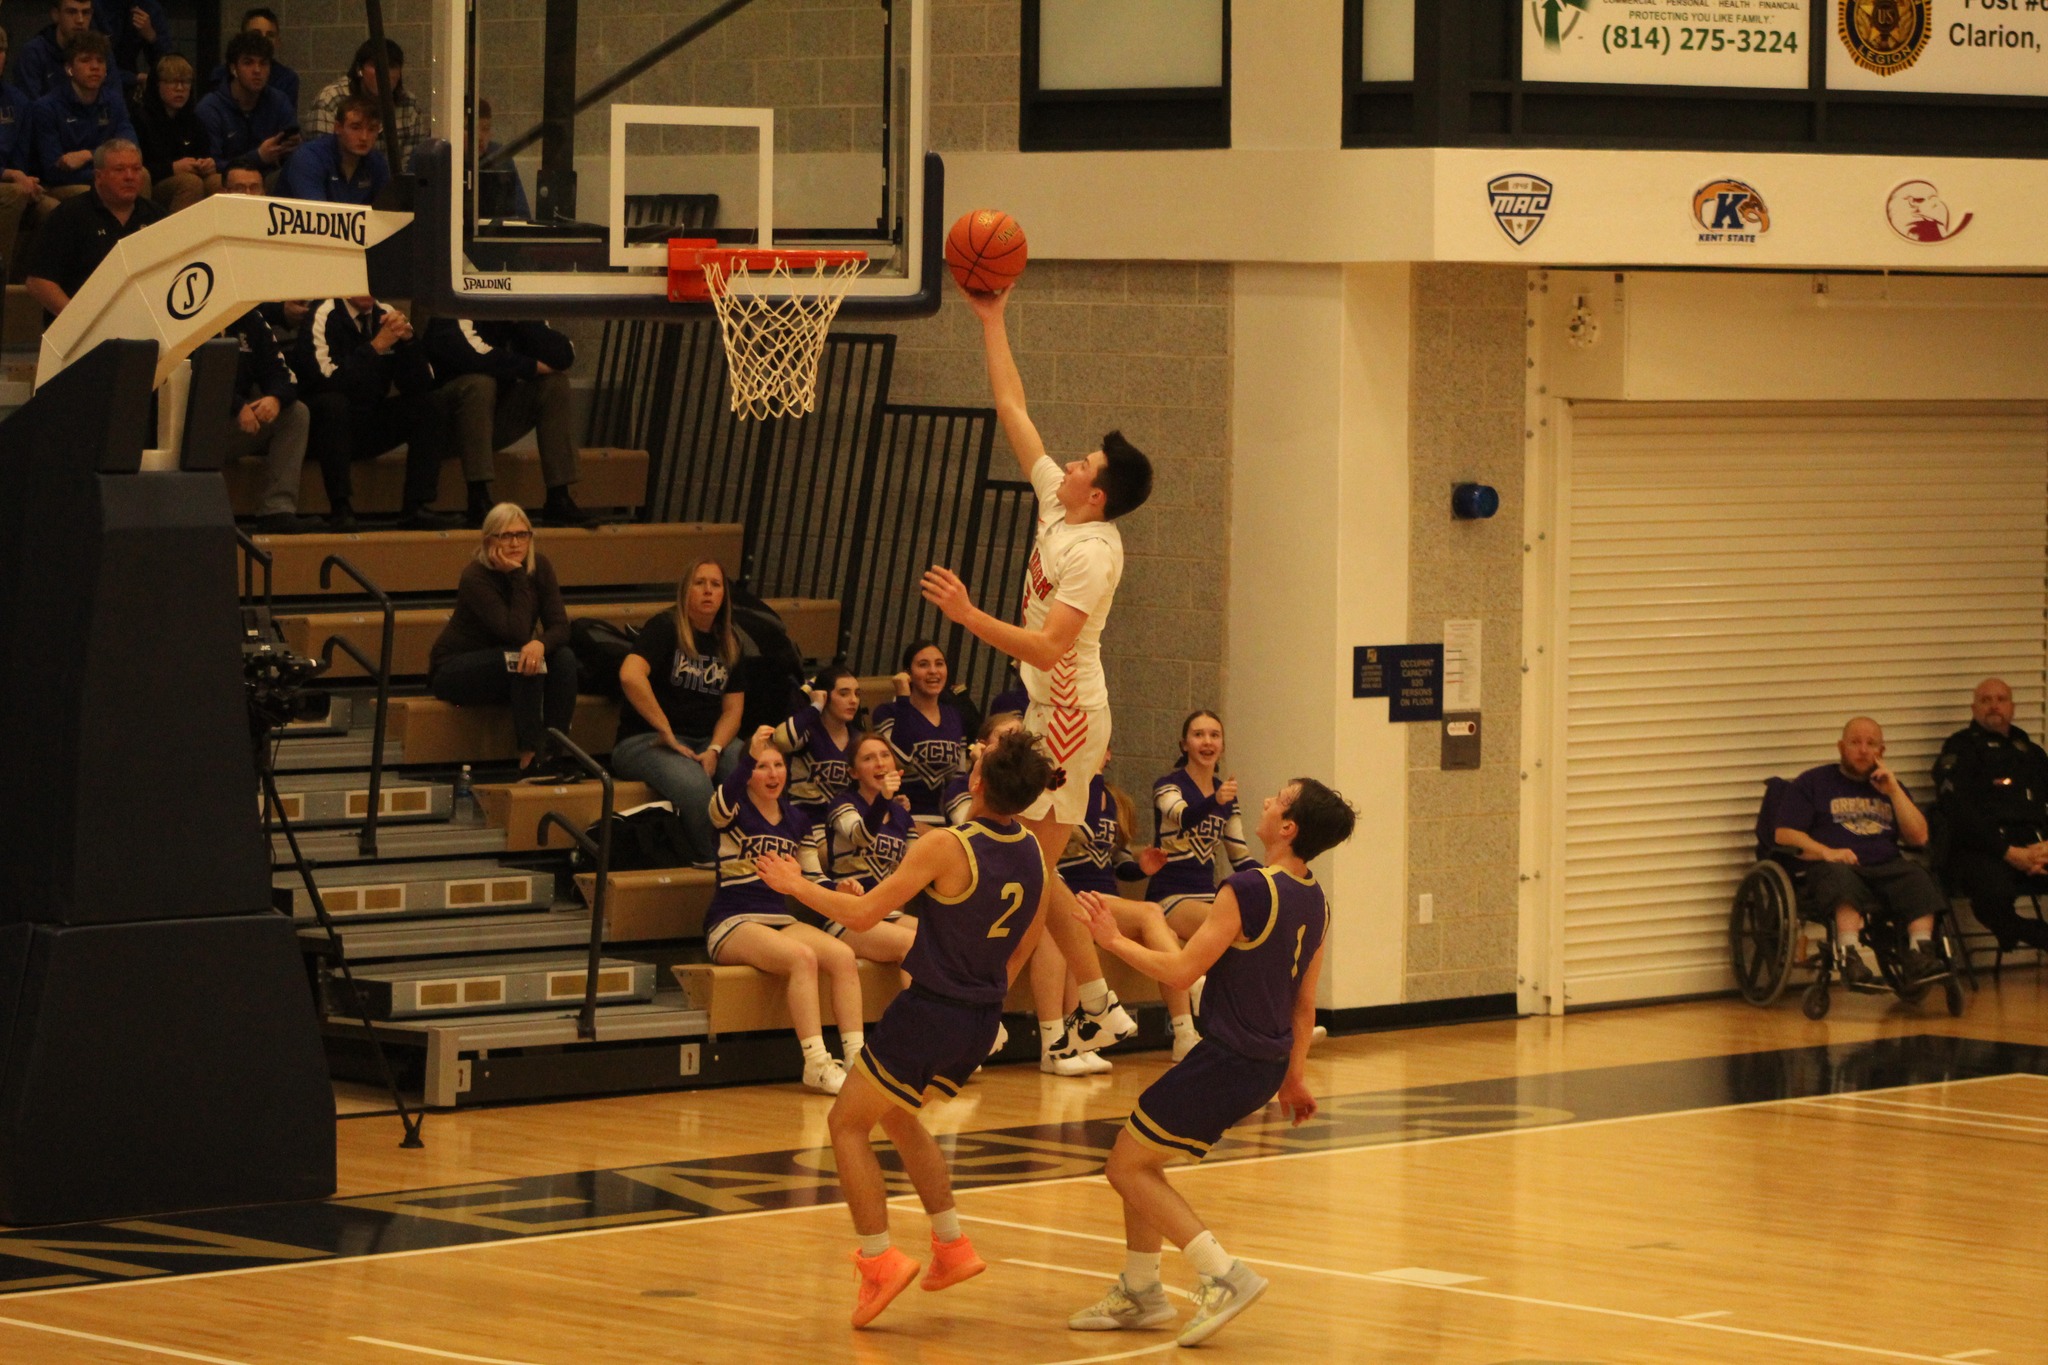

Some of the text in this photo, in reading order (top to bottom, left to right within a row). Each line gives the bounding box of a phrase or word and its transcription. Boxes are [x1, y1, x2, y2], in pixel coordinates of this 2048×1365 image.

[1719, 0, 1751, 8] HEALTH
[1759, 1, 1800, 10] FINANCIAL
[1629, 11, 1689, 21] PROTECTING
[1692, 13, 1711, 22] YOU
[1713, 14, 1734, 23] LIKE
[1878, 9, 1894, 24] US
[1602, 25, 1798, 55] (814) 275-3224
[1949, 22, 2041, 53] Clarion,
[1857, 45, 1912, 65] LEGION
[1493, 195, 1548, 214] MAC
[1711, 193, 1749, 229] K
[267, 202, 366, 246] SPALDING
[1698, 233, 1755, 243] KENT STATE
[463, 277, 512, 291] SPALDING
[987, 883, 1024, 938] 2
[1291, 924, 1307, 980] 1
